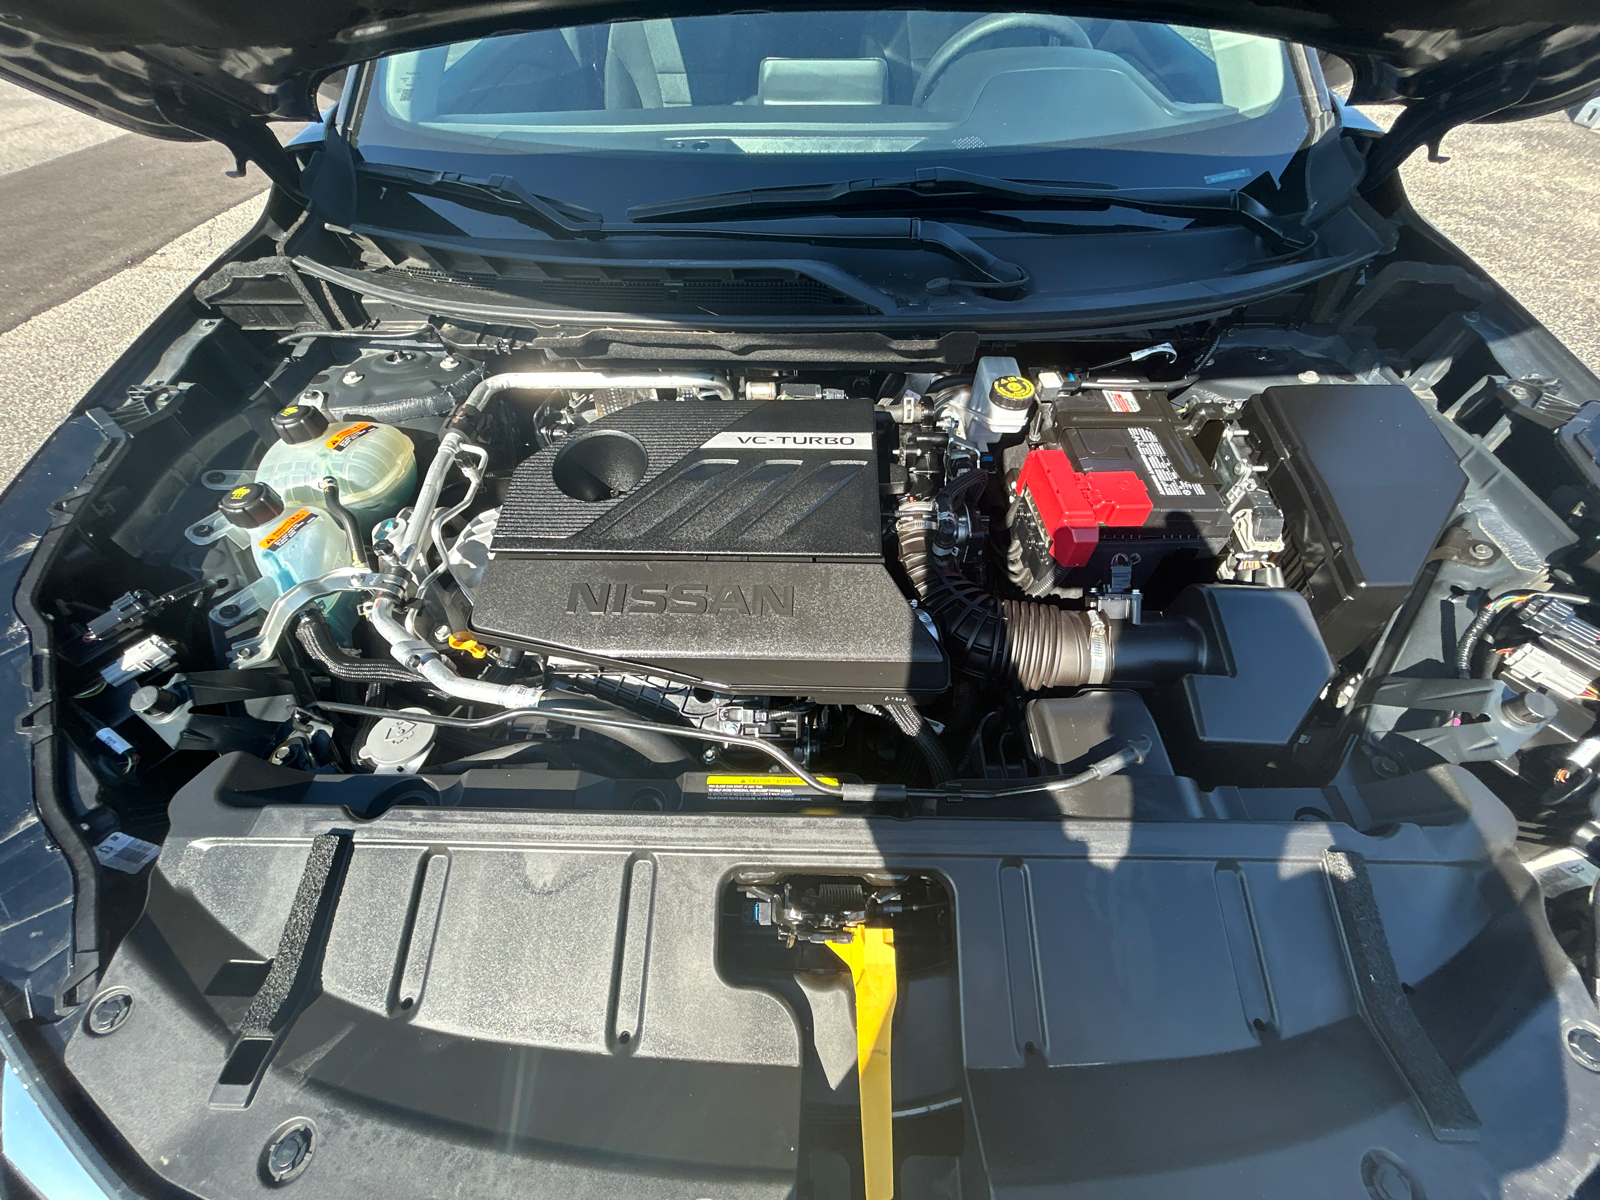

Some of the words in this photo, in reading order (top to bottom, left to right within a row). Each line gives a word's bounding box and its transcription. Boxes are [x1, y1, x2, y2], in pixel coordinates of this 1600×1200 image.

[736, 436, 855, 446] VC-TURBO
[566, 582, 795, 617] NISSAN
[1567, 864, 1585, 873] B
